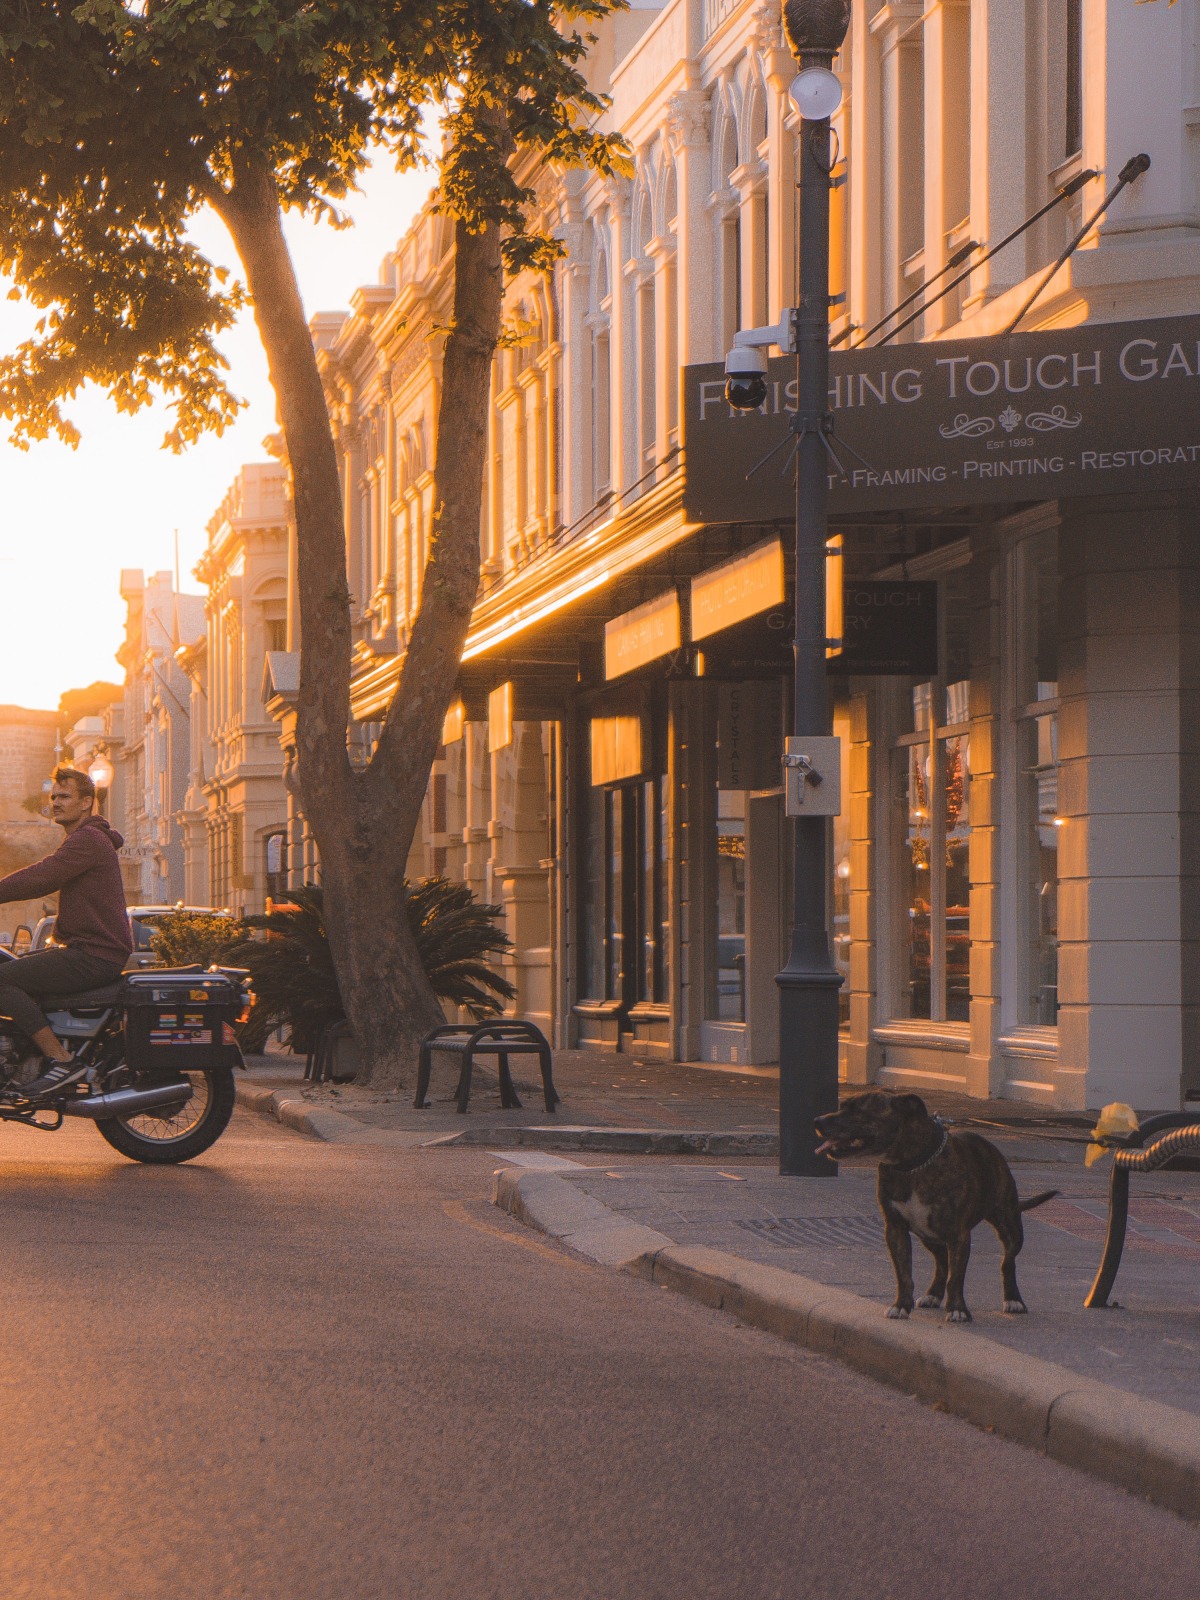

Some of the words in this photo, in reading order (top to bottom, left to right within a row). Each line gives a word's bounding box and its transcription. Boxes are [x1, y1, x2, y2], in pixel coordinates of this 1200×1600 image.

[699, 367, 923, 421] FISHING
[935, 350, 1101, 398] TOUCH
[987, 440, 1006, 450] EST
[1009, 437, 1034, 448] 1993
[853, 465, 947, 488] FRAMING
[963, 456, 1064, 480] PRINTING
[842, 588, 922, 607] TOUCH
[730, 689, 741, 786] CRYSTALS
